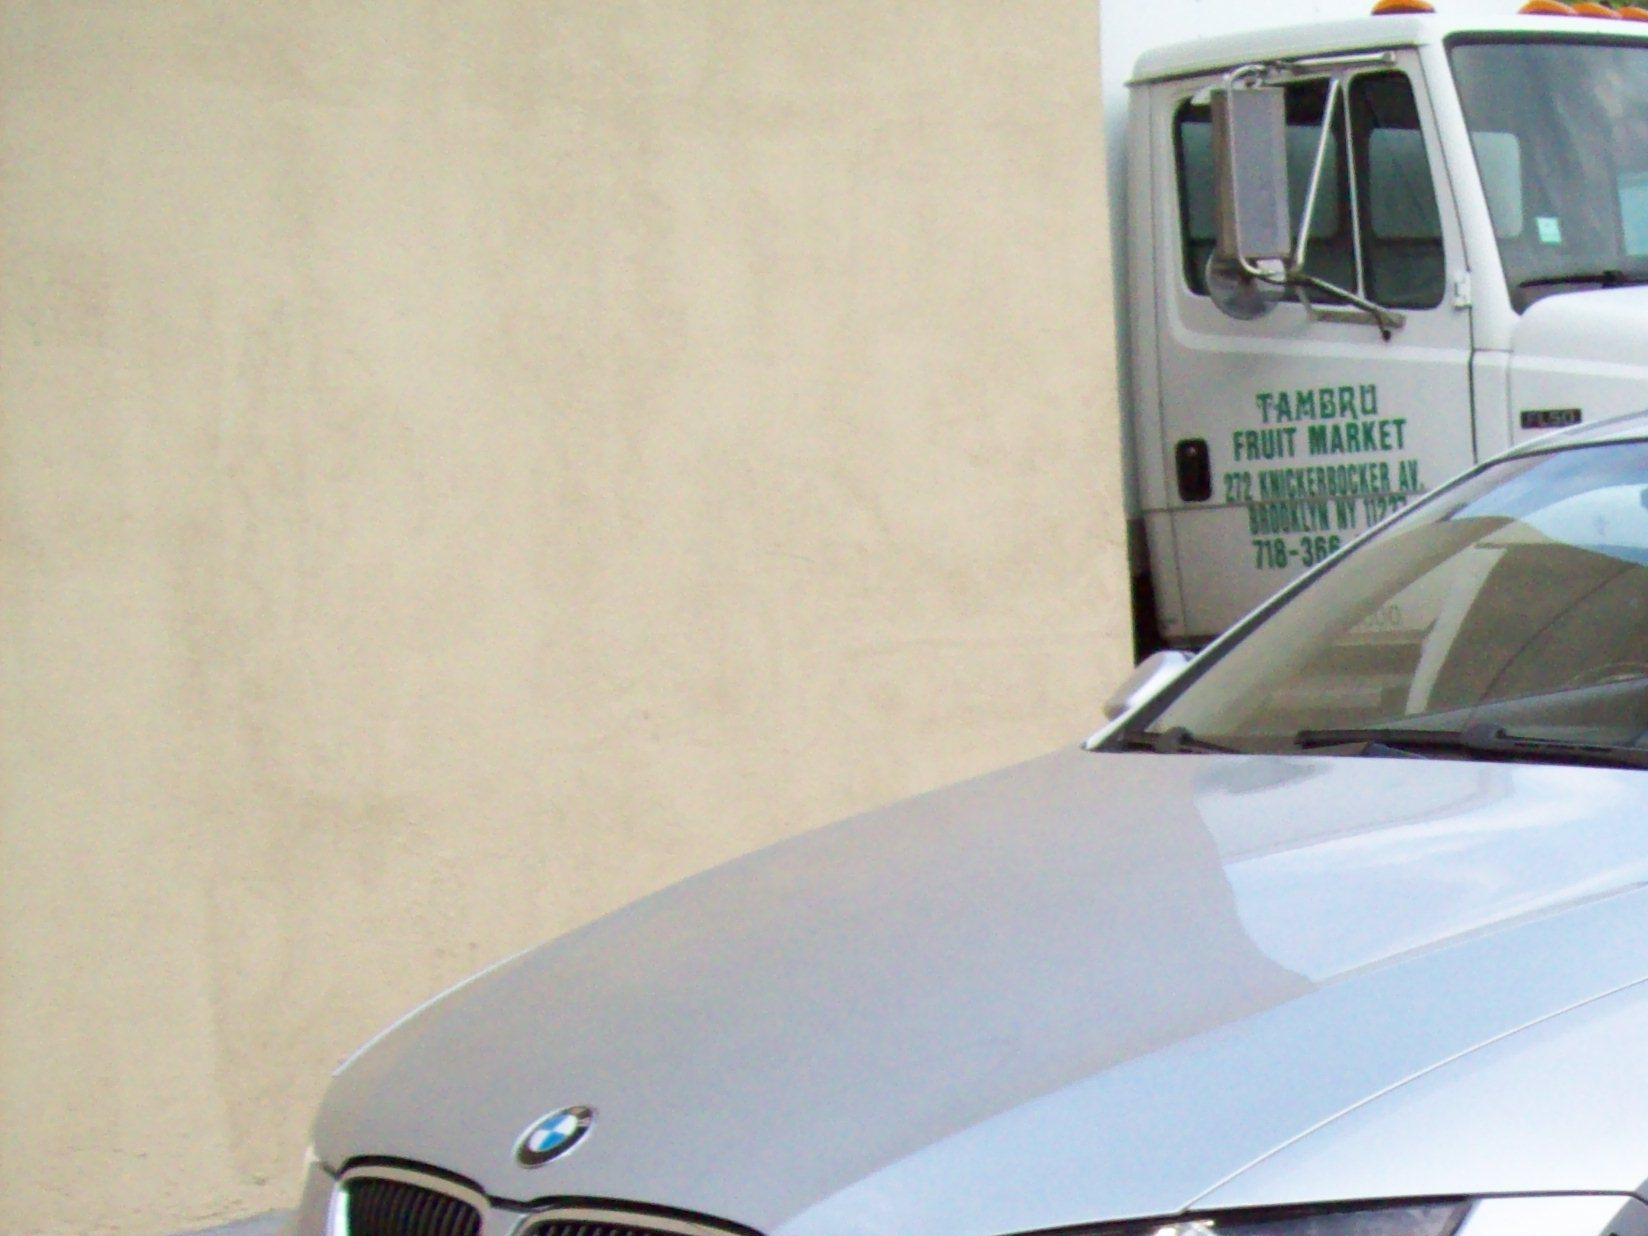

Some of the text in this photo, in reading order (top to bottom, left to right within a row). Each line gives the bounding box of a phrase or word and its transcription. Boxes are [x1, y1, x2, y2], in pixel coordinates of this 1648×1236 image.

[1233, 418, 1407, 462] FRUIT MARKET
[1257, 462, 1391, 500] KNICKERBOCKER
[1248, 498, 1330, 536] BROOKLYN
[1336, 497, 1357, 530] NY
